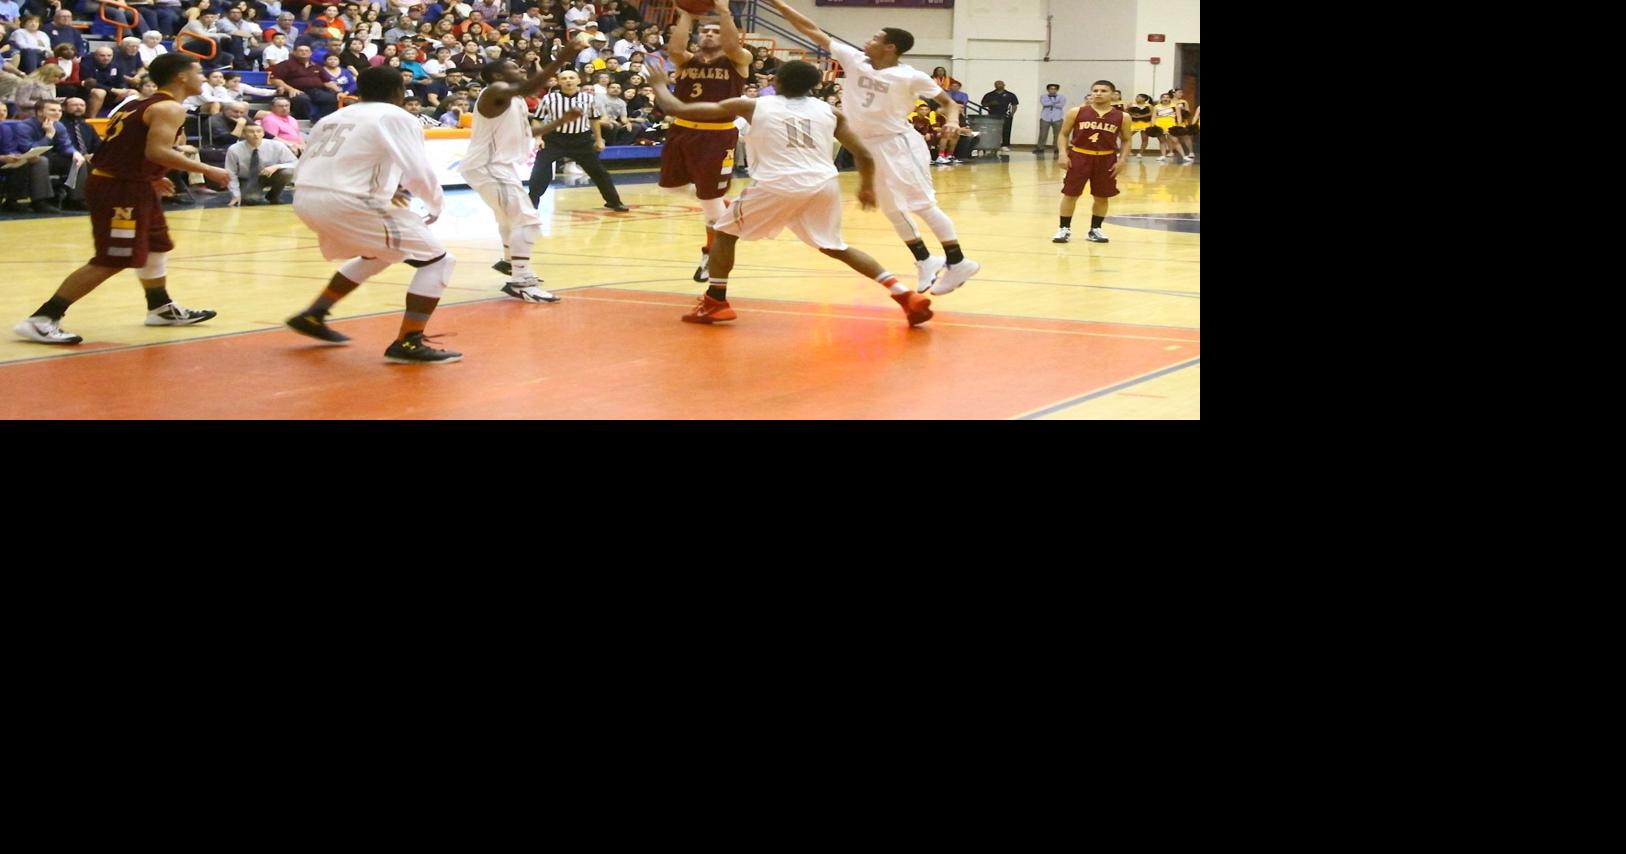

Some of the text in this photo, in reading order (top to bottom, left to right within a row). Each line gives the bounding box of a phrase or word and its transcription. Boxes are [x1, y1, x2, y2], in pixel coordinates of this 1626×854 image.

[689, 82, 704, 98] 3
[784, 117, 817, 149] 11
[1087, 132, 1100, 143] 4
[111, 206, 135, 220] N
